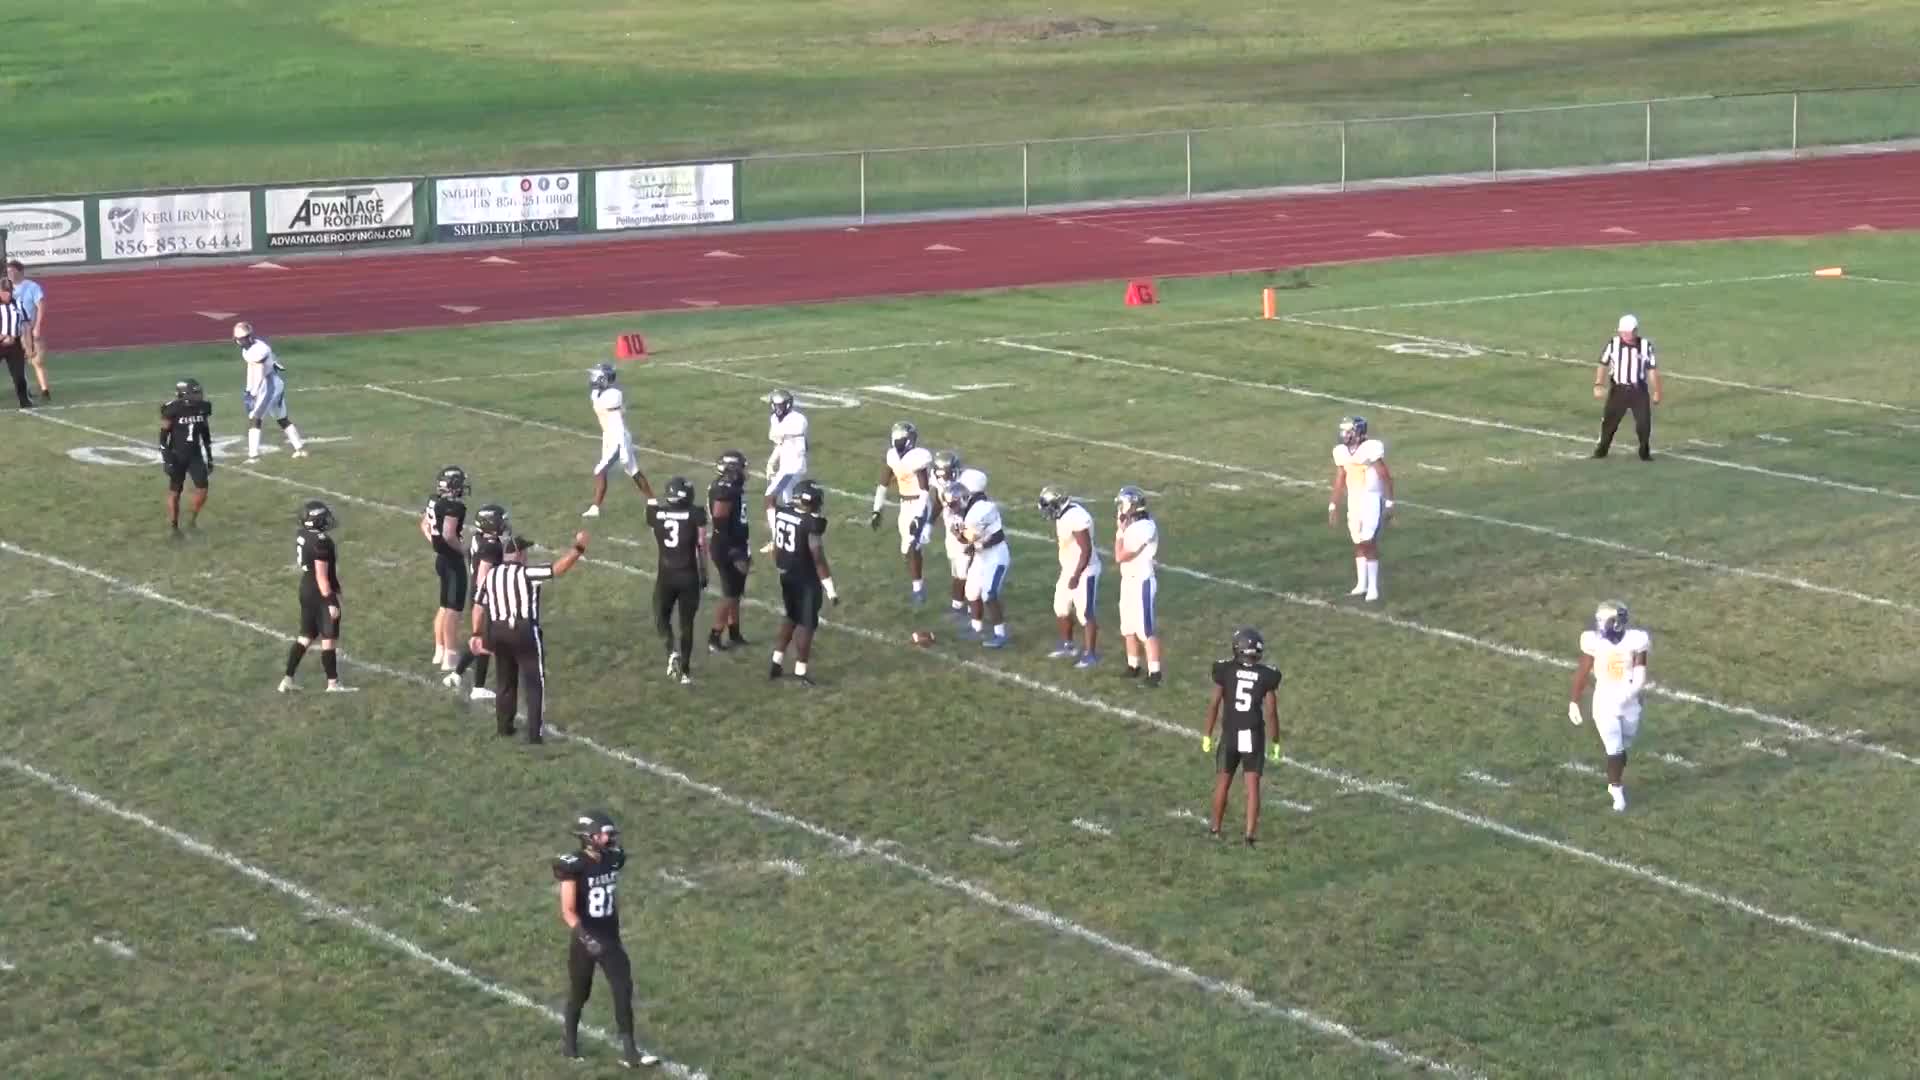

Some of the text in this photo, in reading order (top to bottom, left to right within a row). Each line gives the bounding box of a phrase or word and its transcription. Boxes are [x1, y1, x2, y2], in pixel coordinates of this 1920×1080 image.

[142, 211, 173, 225] KERI
[177, 206, 227, 222] IRVING
[288, 194, 384, 229] ADVANTAGE
[323, 211, 384, 227] ROOFING
[114, 231, 243, 256] 856-853-6444
[269, 227, 413, 247] ADVANTAGEROOFINGNJ.COM
[622, 333, 645, 356] 10
[186, 423, 195, 442] 1
[663, 519, 680, 549] 3
[775, 519, 797, 553] 63
[1234, 679, 1255, 712] 5
